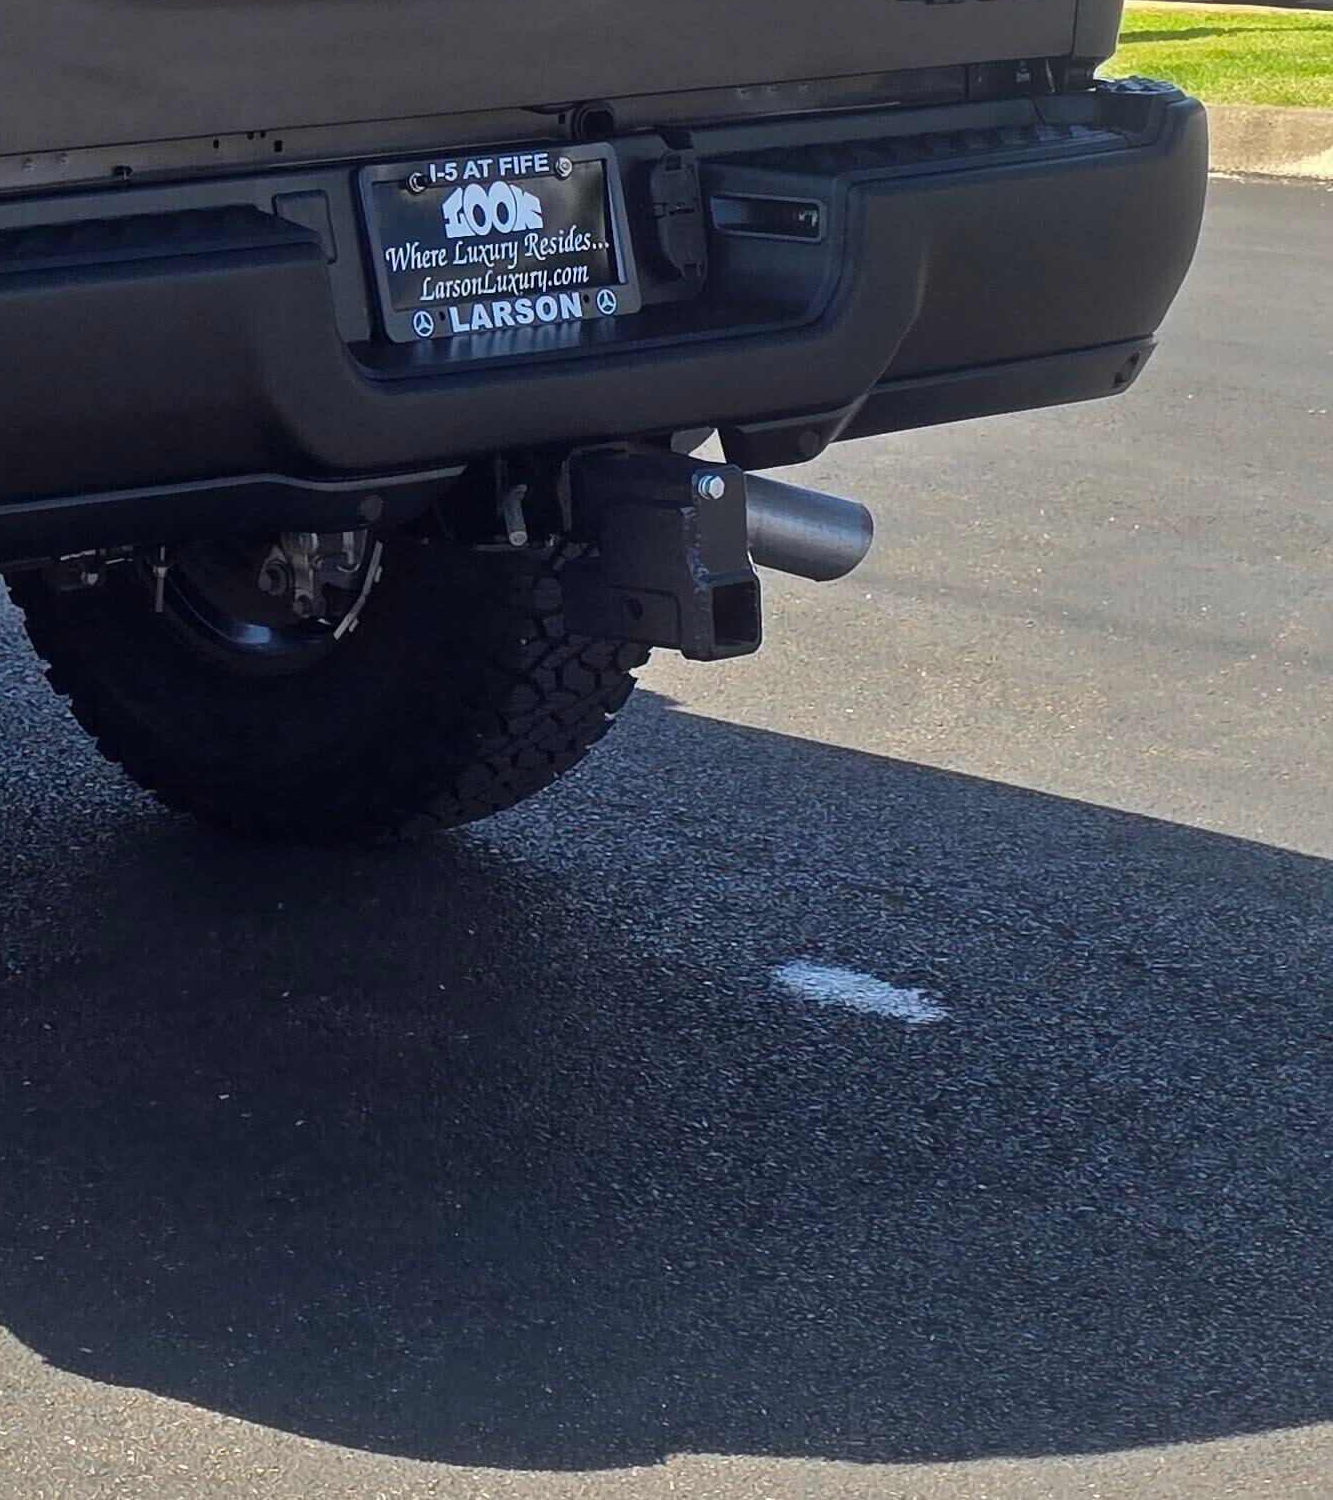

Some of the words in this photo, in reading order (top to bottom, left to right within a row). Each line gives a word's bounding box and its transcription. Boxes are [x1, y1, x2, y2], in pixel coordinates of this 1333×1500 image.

[429, 162, 458, 183] I-5
[463, 159, 493, 180] AT
[499, 153, 550, 176] FIFE
[442, 181, 544, 238] LOOK
[385, 242, 447, 272] Where
[453, 240, 519, 269] Luxury
[524, 225, 610, 260] Resides...
[420, 264, 590, 301] LarsonLuxury.com
[448, 291, 583, 333] LARSON
